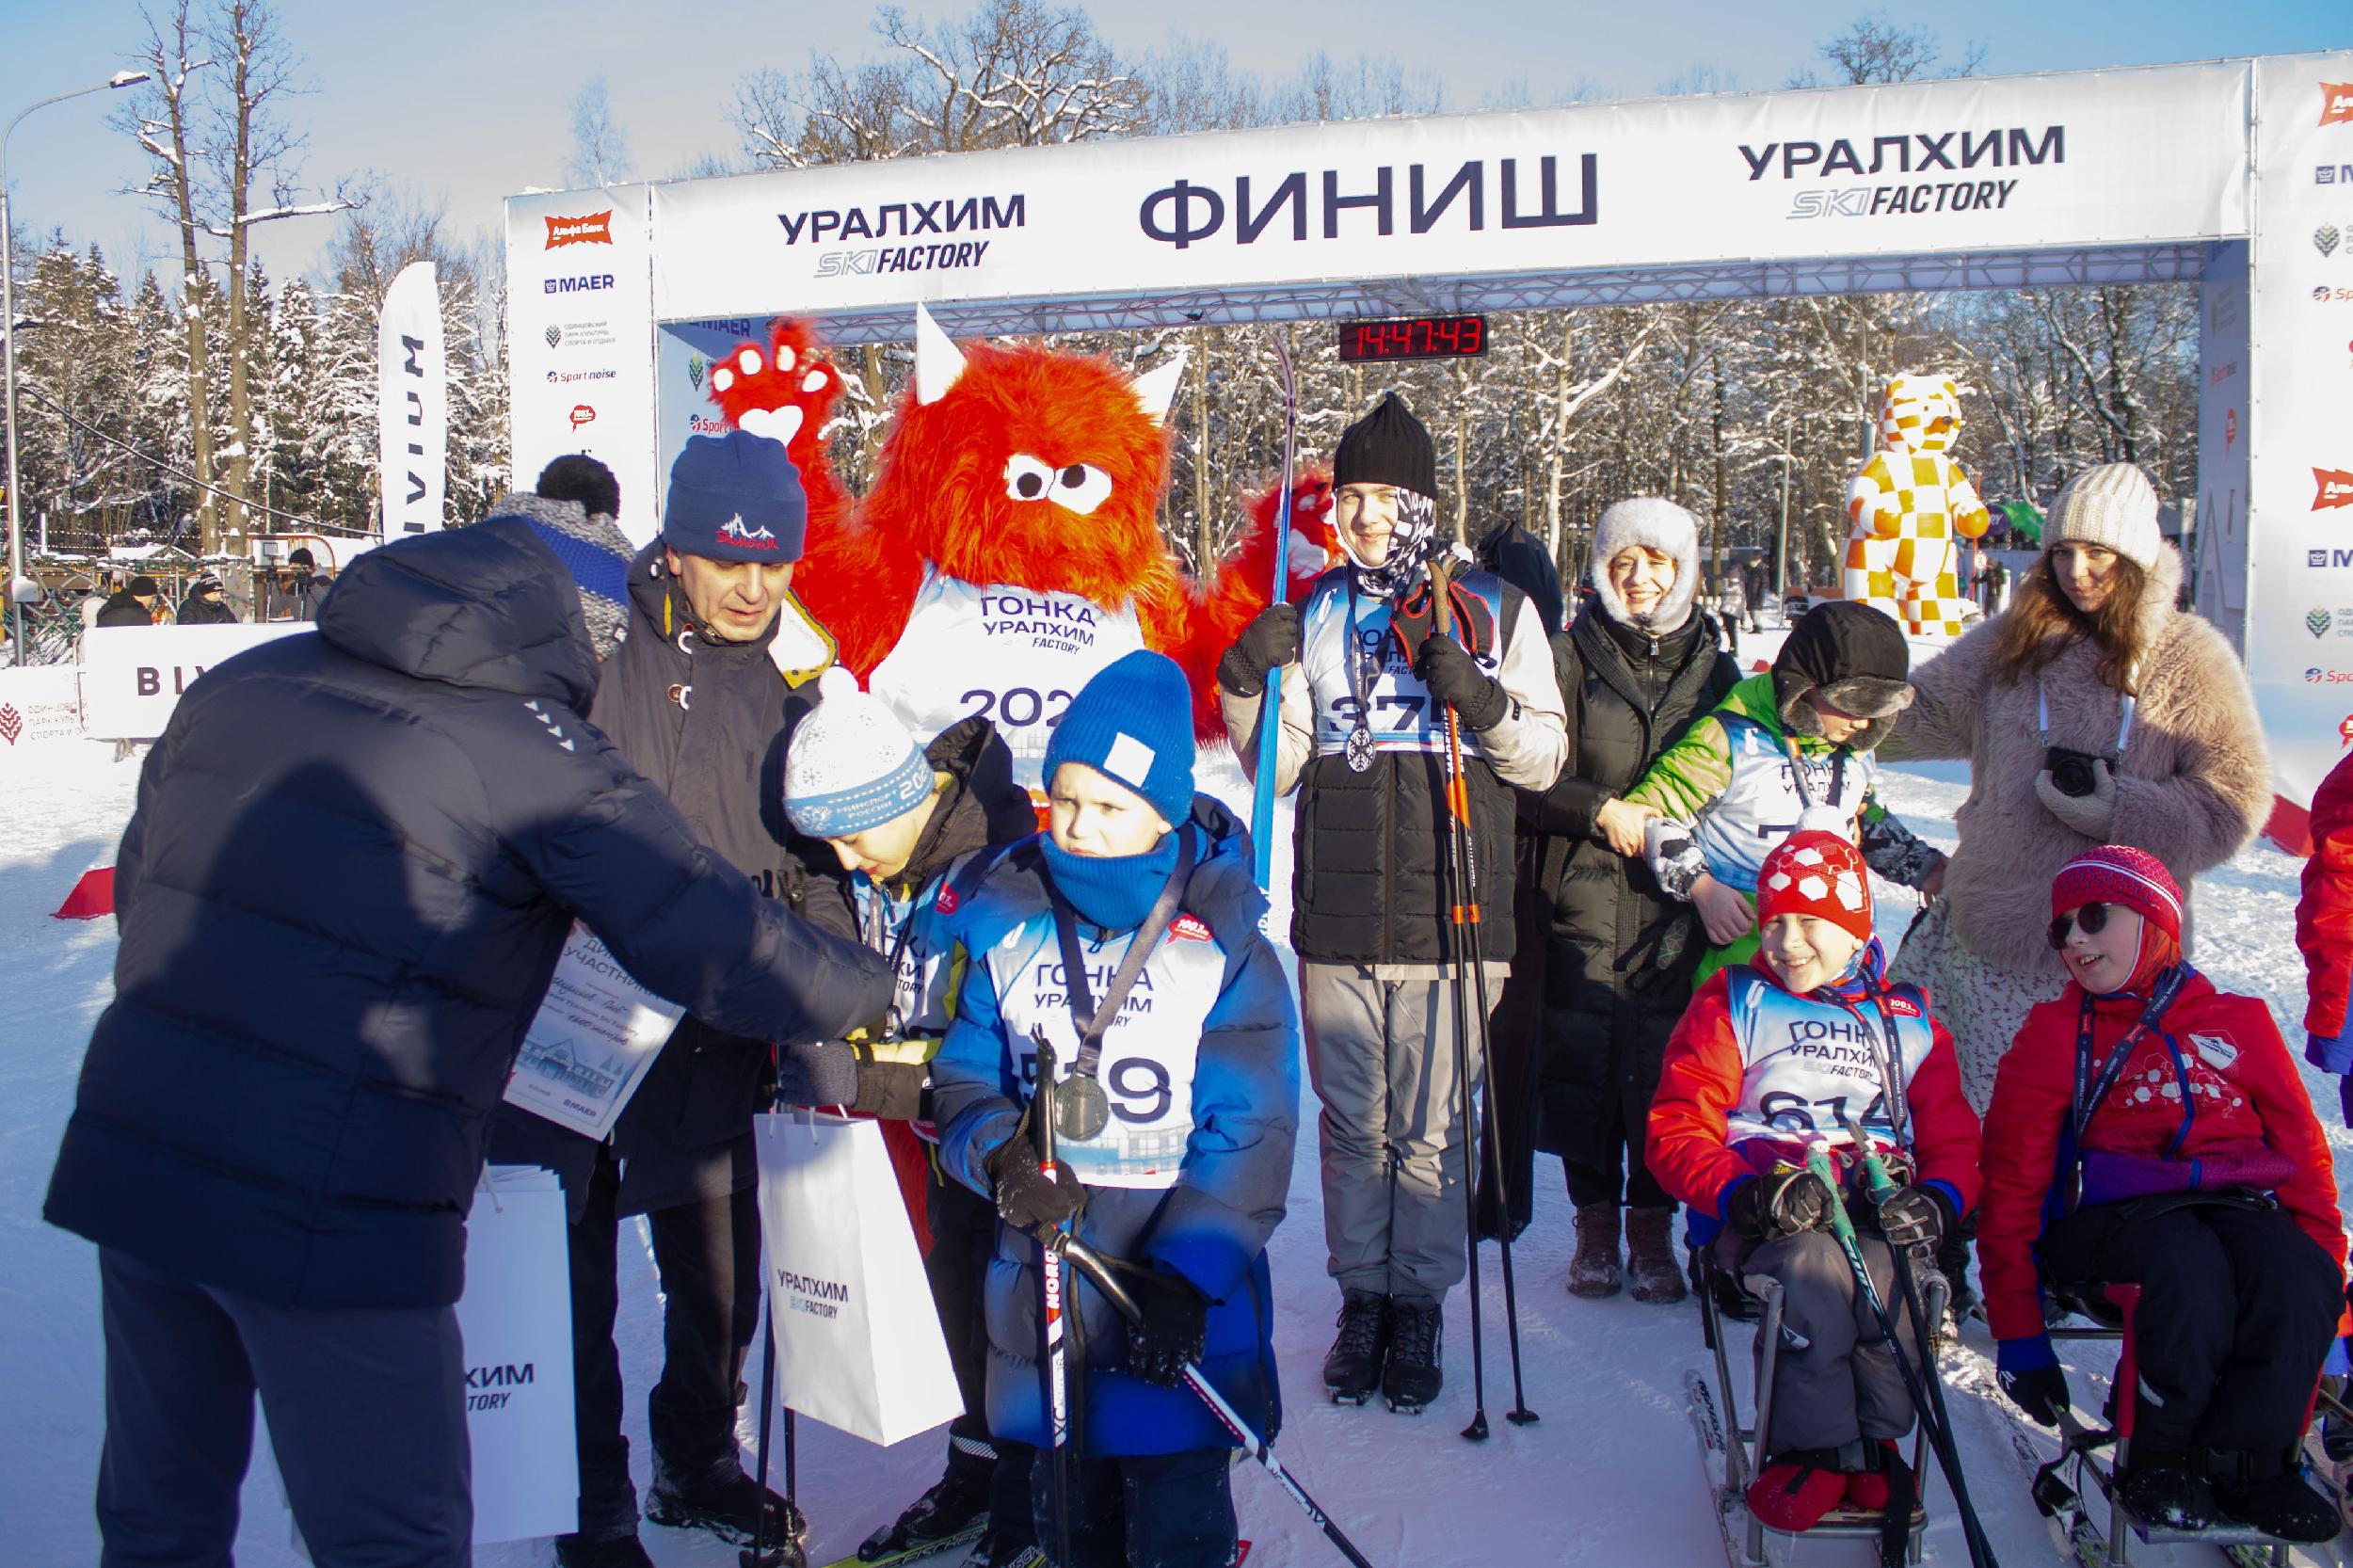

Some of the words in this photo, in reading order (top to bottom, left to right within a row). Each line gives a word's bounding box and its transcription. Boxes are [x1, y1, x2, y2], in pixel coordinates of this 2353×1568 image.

[1737, 125, 2065, 181] УРАЛХИМ
[1140, 153, 1597, 249] ФИНИШ
[777, 194, 1025, 245] УРАЛХИМ
[559, 274, 615, 292] MAER
[1357, 318, 1481, 357] 14:47:43
[561, 372, 588, 383] Sport
[589, 368, 616, 379] noise
[981, 596, 1096, 628] ГОНКА
[983, 620, 1094, 647] УРАЛХИМ
[1032, 637, 1080, 655] FACTORY
[777, 1269, 848, 1303] УРАЛХИМ
